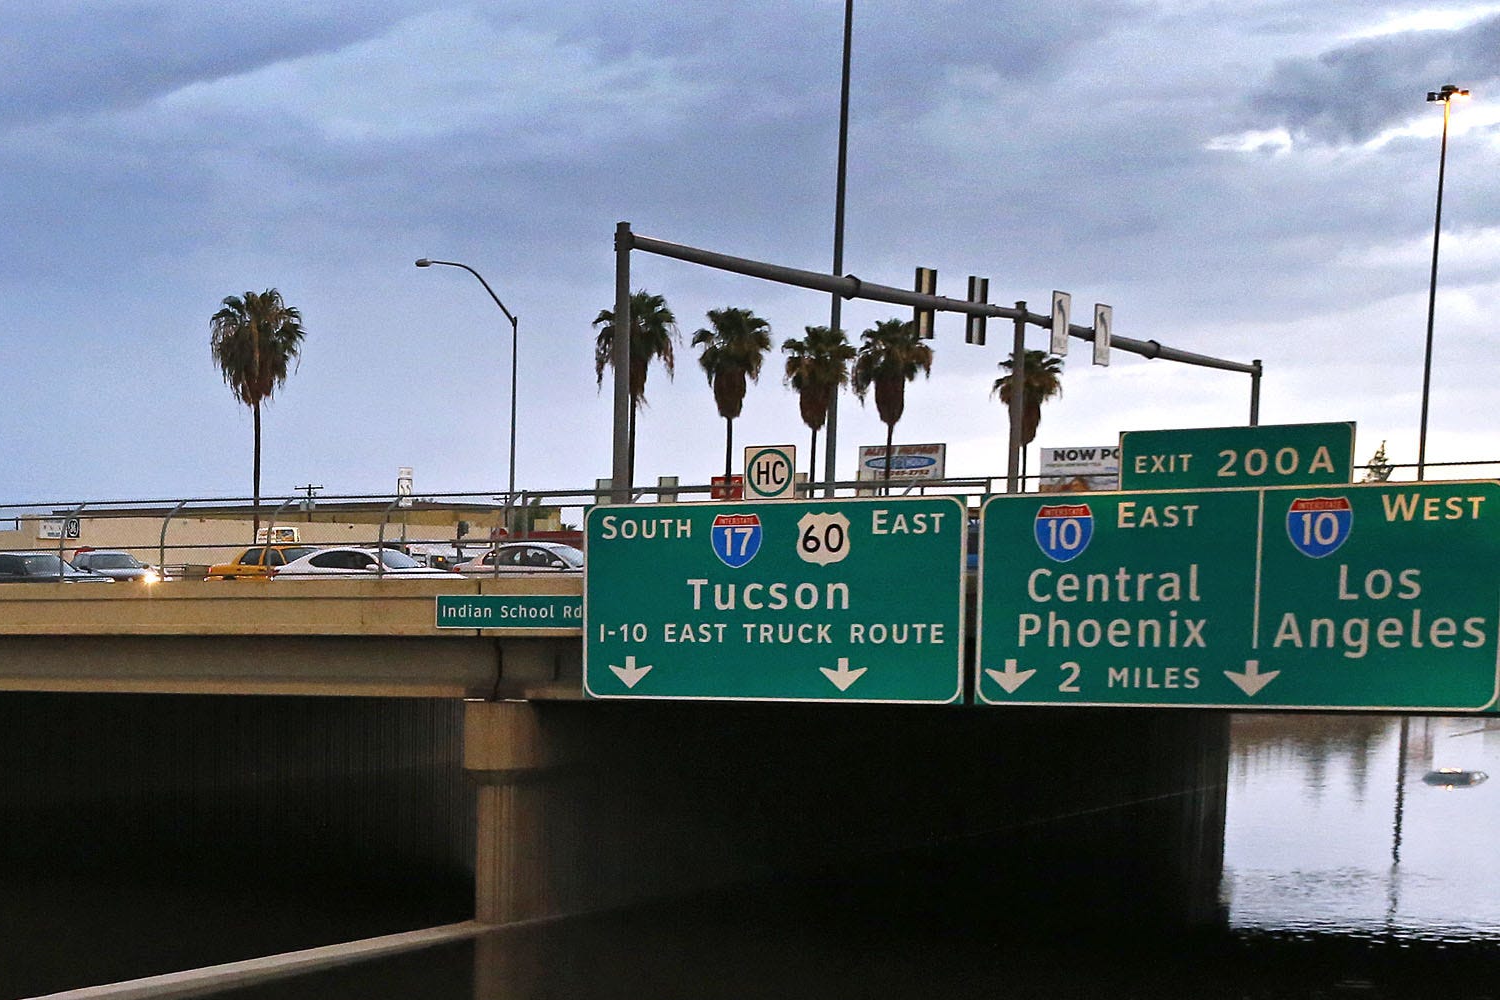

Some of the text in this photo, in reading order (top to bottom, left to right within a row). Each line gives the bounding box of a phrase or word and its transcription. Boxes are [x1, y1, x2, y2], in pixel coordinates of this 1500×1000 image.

[1053, 449, 1096, 462] NOW
[1134, 454, 1193, 474] EXIT
[756, 460, 785, 486] HC
[872, 509, 945, 535] EAST
[1117, 501, 1199, 528] EAST
[1381, 493, 1486, 522] WEST
[601, 515, 692, 540] SOUTH
[723, 527, 754, 557] 17
[802, 523, 844, 553] 60
[1047, 518, 1082, 550] 10
[1301, 512, 1339, 546] 10
[687, 578, 850, 611] Tucson
[1027, 564, 1201, 603] Central
[1338, 564, 1422, 600] Los
[442, 604, 582, 618] Indian School Rd
[600, 622, 944, 644] I-10 EAST TRUCK ROUTE
[1018, 610, 1206, 649] Phoenix
[1273, 609, 1487, 659] Angeles
[1058, 661, 1200, 692] 2 MILES
